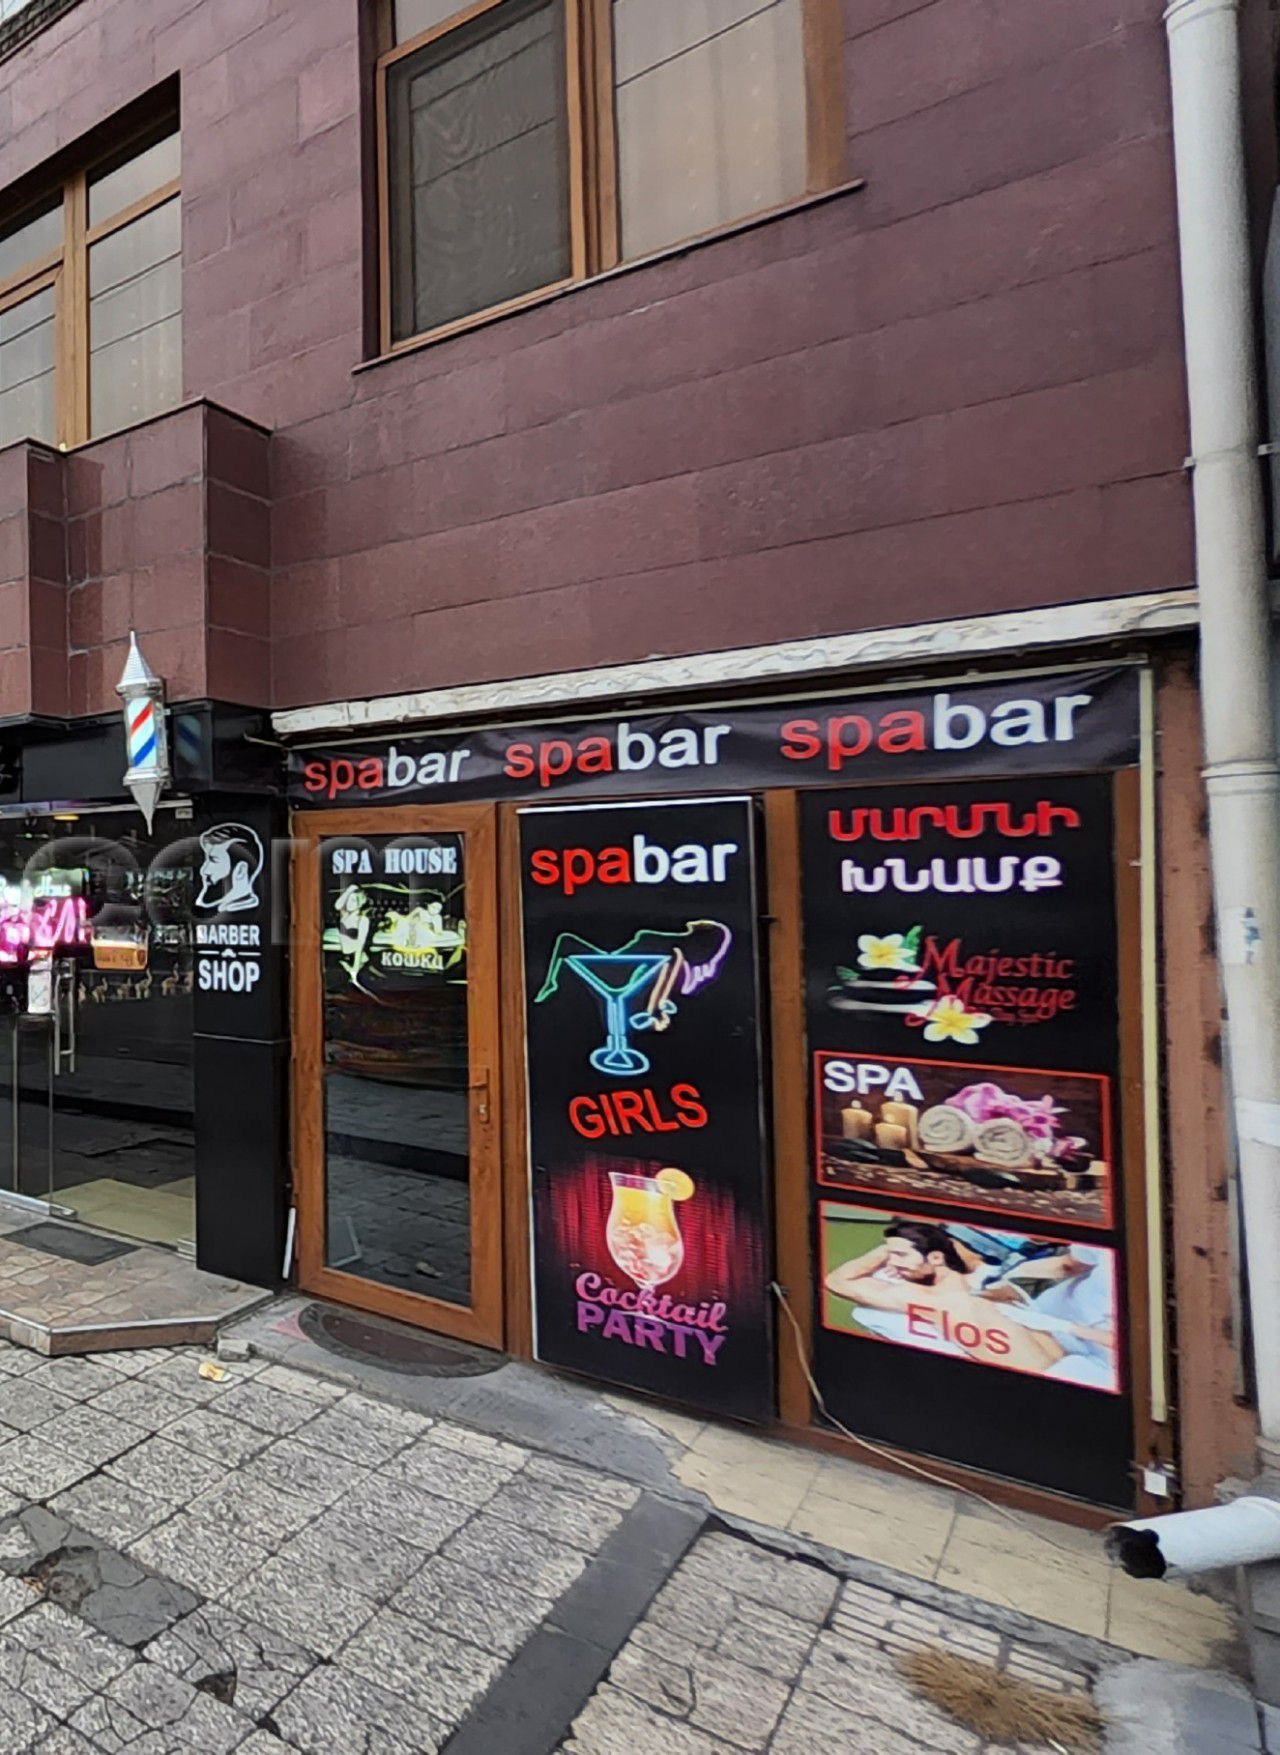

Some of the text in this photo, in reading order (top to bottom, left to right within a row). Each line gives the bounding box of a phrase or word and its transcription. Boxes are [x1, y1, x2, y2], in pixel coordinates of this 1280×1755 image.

[503, 723, 731, 788] spabar
[780, 693, 1093, 771] spabar
[304, 747, 470, 800] spabar
[828, 800, 1081, 841] ՄԱՐՄՆԻ
[332, 846, 458, 875] SPA HOUSE
[530, 834, 738, 896] spabar
[841, 855, 1063, 893] ԽՆԱՄՔ
[196, 924, 260, 945] BARBER
[198, 958, 260, 992] SHOP
[892, 935, 1074, 990] Majestic
[904, 971, 1076, 1027] Massage
[823, 1060, 924, 1101] SPA
[569, 1083, 708, 1139] GIRLS
[575, 1272, 728, 1331] Cocktail
[906, 1302, 1011, 1355] Elos
[576, 1301, 727, 1366] PARTY
